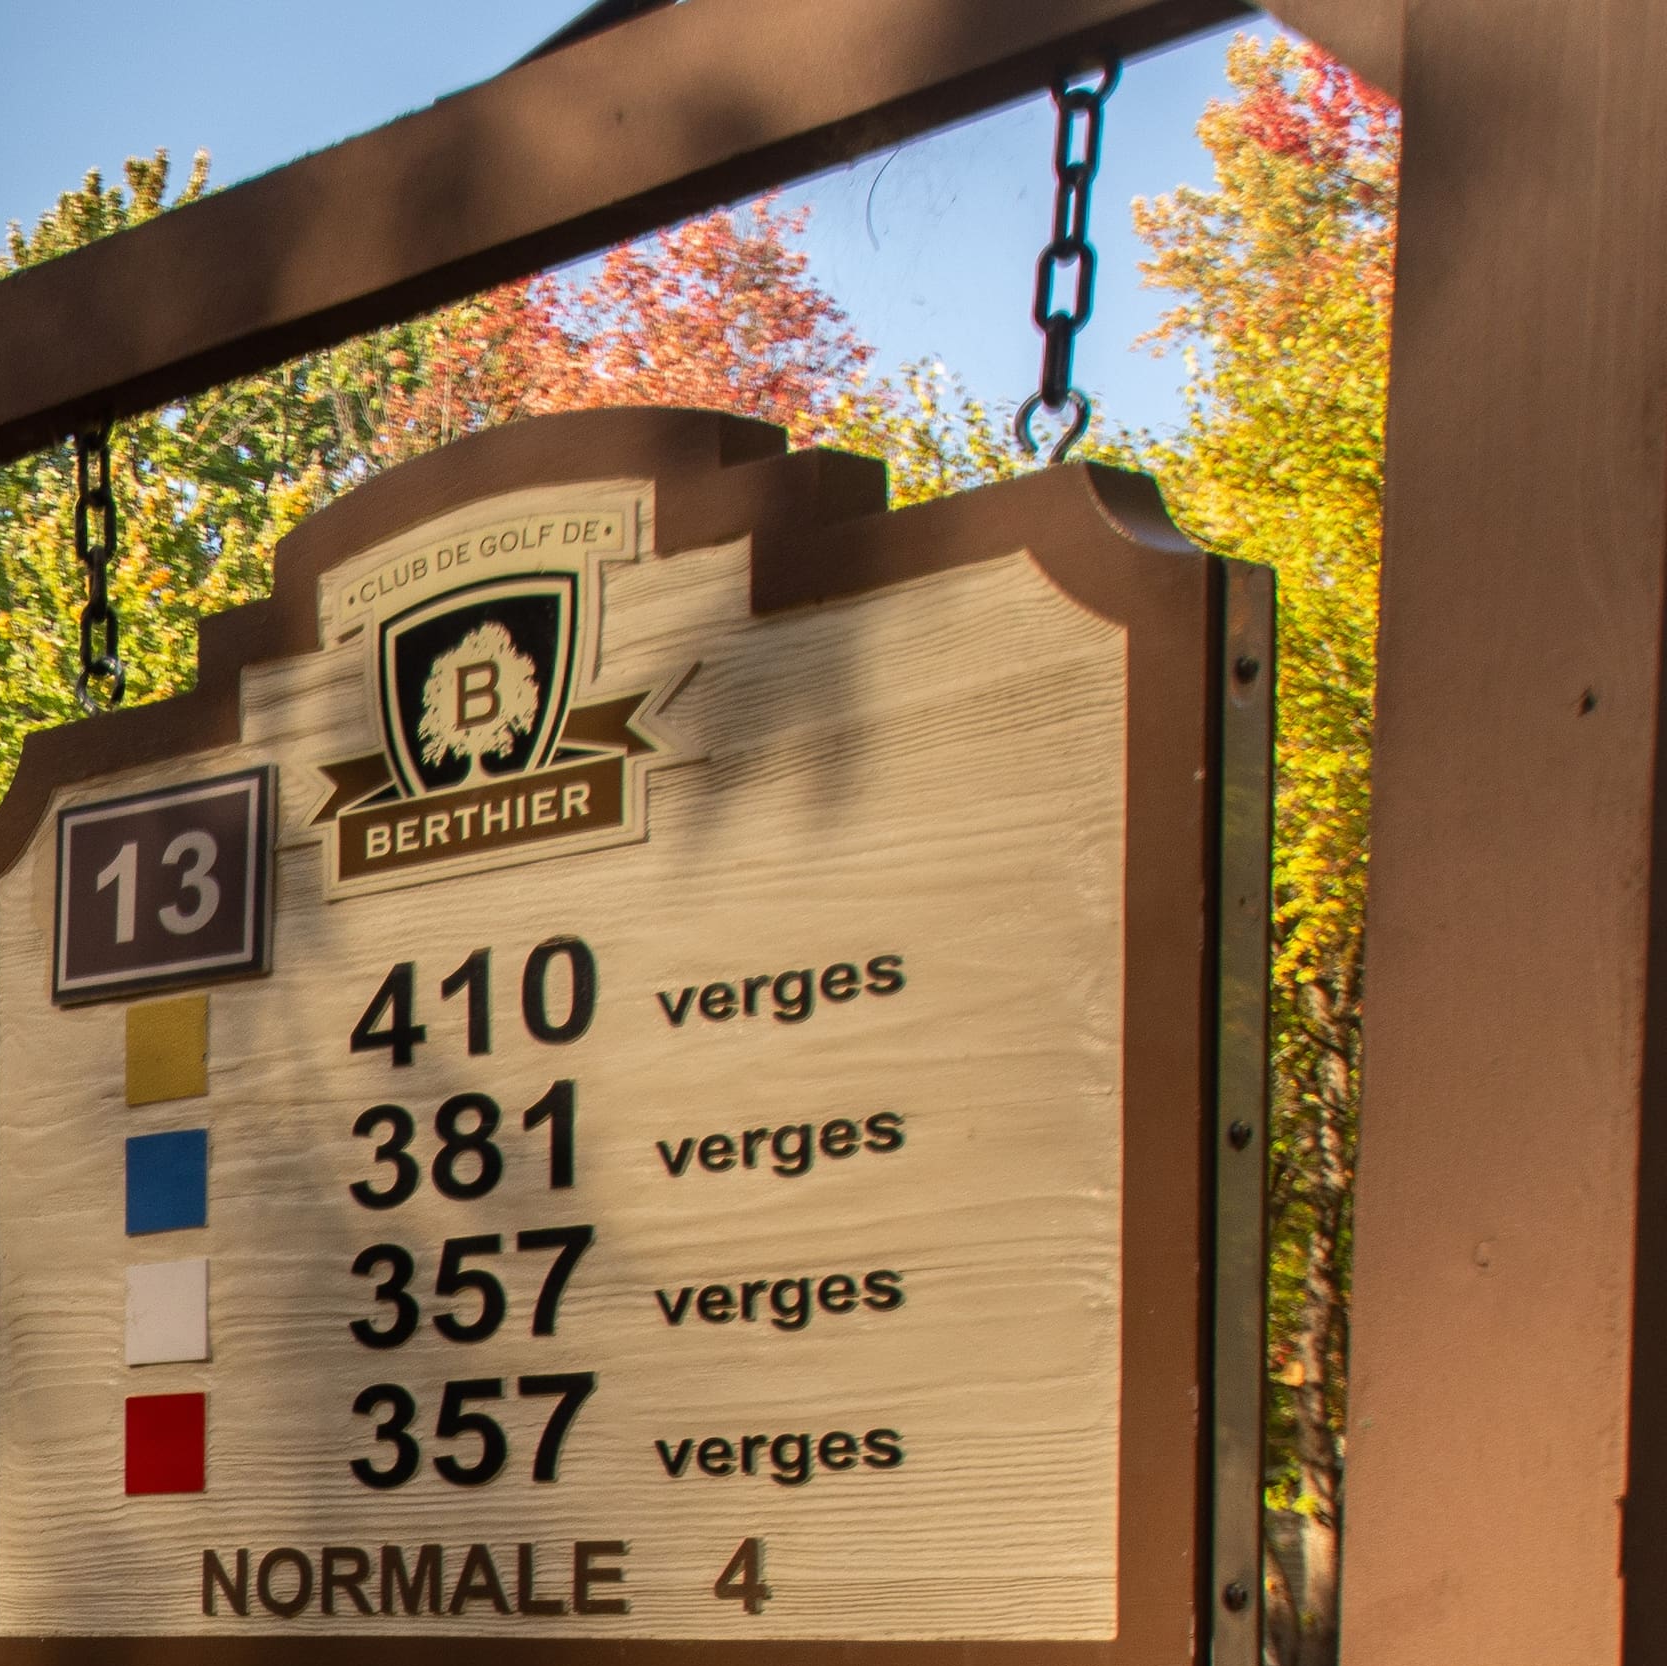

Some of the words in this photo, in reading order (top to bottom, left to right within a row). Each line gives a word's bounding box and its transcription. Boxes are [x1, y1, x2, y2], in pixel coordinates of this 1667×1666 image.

[359, 557, 429, 604] CLUB
[435, 543, 472, 577] DE
[478, 523, 556, 561] GOLF
[559, 520, 600, 546] DE
[456, 661, 501, 729] B
[364, 782, 591, 859] BERTHIER
[95, 831, 220, 945] 13
[350, 936, 599, 1068] 410
[658, 951, 904, 1027] verges
[349, 1079, 578, 1211] 381
[658, 1103, 904, 1177] verges
[349, 1225, 597, 1350] 357
[656, 1262, 903, 1331] verges
[349, 1371, 599, 1491] 357
[656, 1422, 903, 1486] verges
[201, 1540, 629, 1617] NORMALE
[713, 1538, 769, 1615] 4
